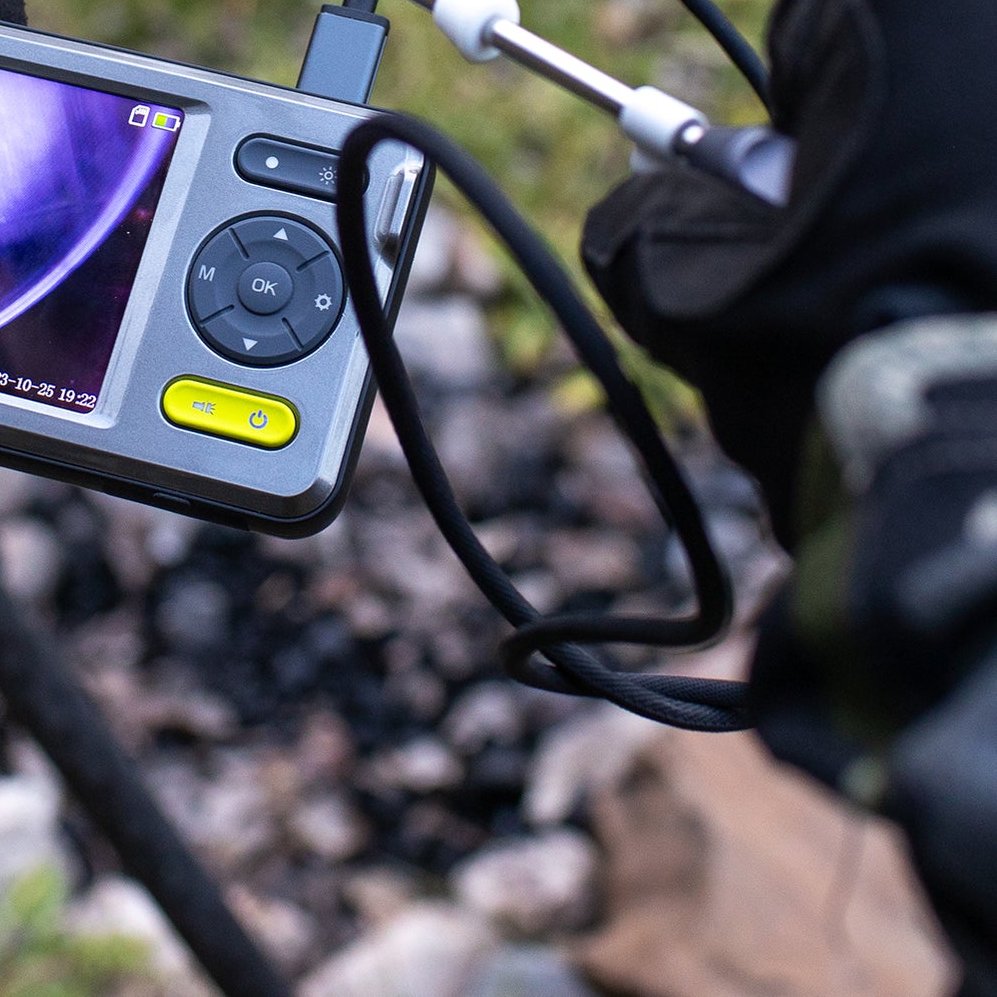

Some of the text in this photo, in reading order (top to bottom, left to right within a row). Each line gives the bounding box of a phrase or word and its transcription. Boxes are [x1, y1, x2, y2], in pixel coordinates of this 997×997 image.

[198, 264, 216, 282] M
[251, 277, 279, 297] OK
[57, 387, 97, 409] 19:22
